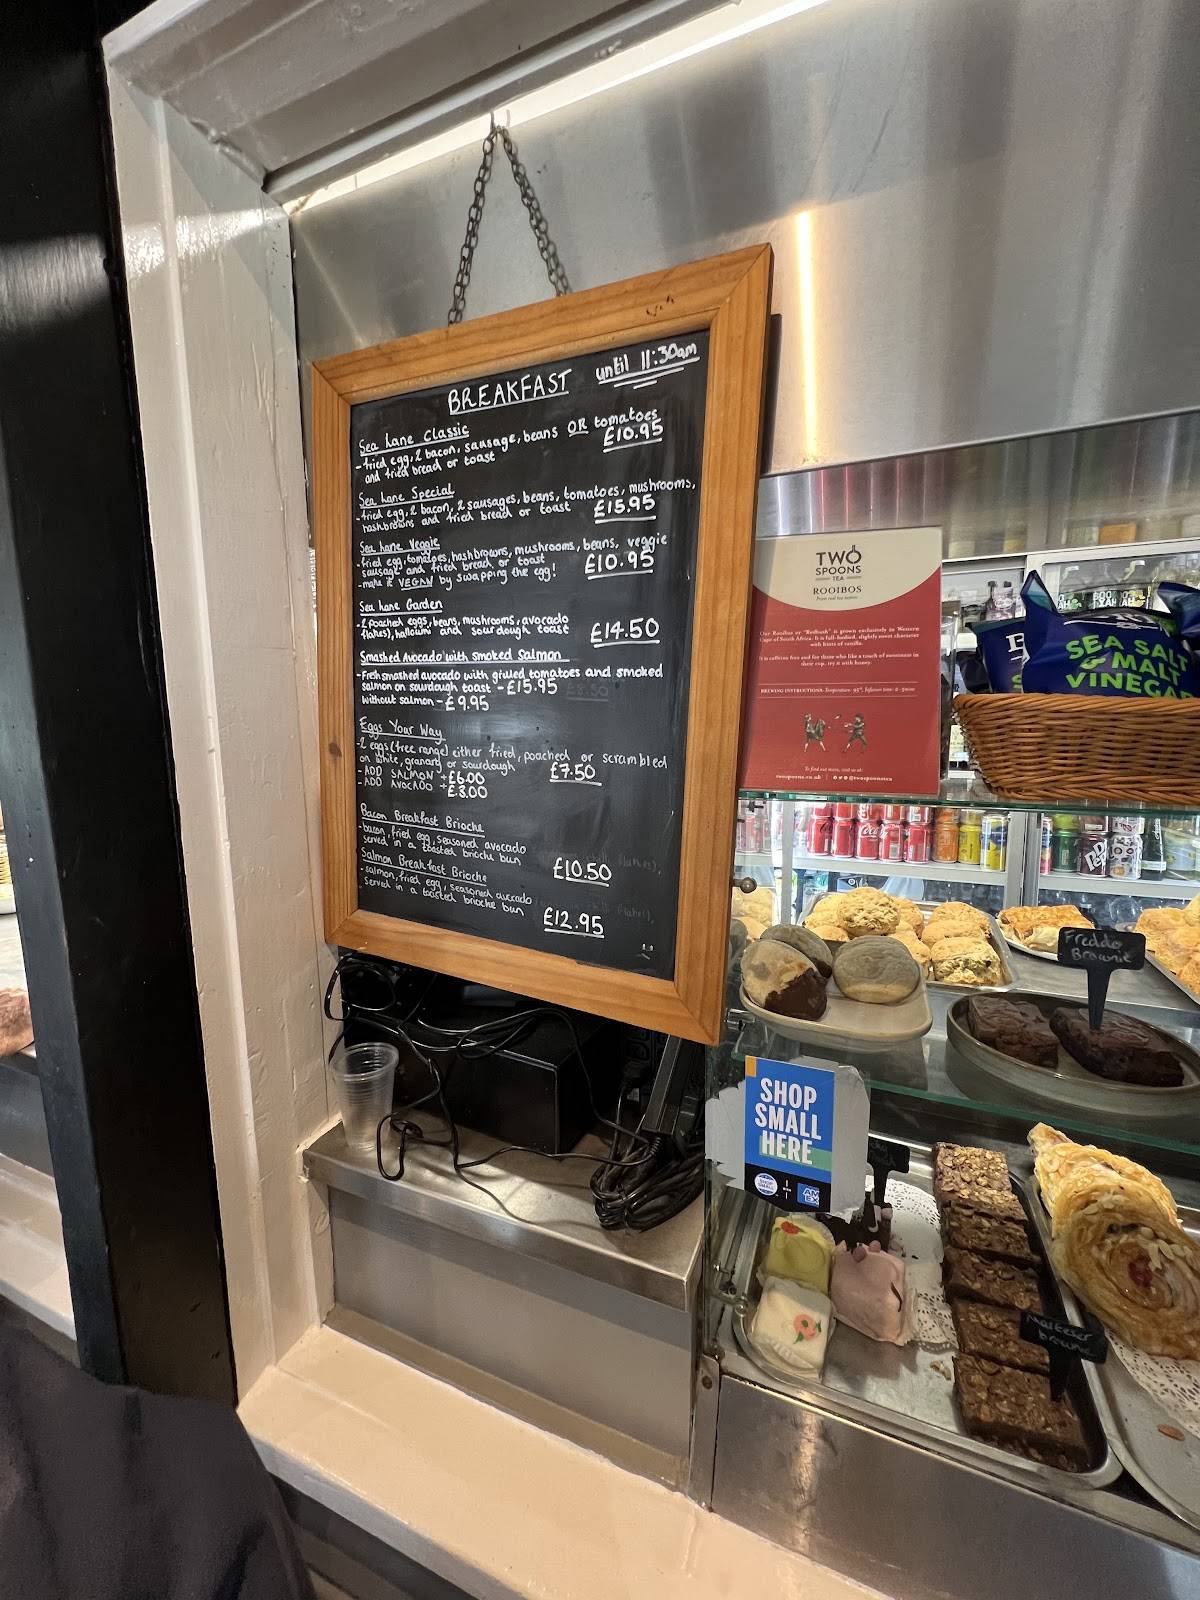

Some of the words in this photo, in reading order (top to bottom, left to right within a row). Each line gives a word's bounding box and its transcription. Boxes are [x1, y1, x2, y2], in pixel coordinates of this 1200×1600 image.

[595, 353, 629, 381] until
[641, 342, 697, 369] 11:30am
[448, 369, 573, 413] BREAKFAST
[359, 439, 380, 454] Sea
[424, 422, 469, 442] Classic
[425, 445, 461, 459] bacon,
[464, 433, 521, 452] sausage,
[523, 427, 558, 443] beans
[567, 417, 588, 434] OR
[594, 406, 658, 429] tomatoes
[603, 418, 664, 447] £10.95
[365, 471, 381, 484] and
[385, 466, 409, 479] fried
[412, 459, 442, 475] bread
[447, 458, 459, 469] or
[464, 450, 496, 466] toast
[358, 492, 377, 506] Sea
[412, 483, 455, 502] Special
[467, 493, 520, 511] sausages,
[523, 490, 560, 504] beans,
[564, 485, 625, 501] tomatoes,
[628, 478, 696, 494] mushrooms,
[594, 494, 656, 518] £15.95
[421, 516, 440, 526] and
[446, 512, 474, 523] fried
[480, 507, 512, 521] bread
[518, 507, 531, 517] or
[540, 501, 571, 515] toast
[360, 541, 376, 553] Sea
[409, 536, 440, 555] Veggie
[514, 540, 580, 556] mushrooms,
[627, 533, 667, 553] veggie
[816, 545, 862, 566] TWO
[362, 567, 400, 580] sausage
[406, 565, 425, 576] and
[431, 562, 457, 573] fried
[462, 557, 492, 571] bread
[498, 559, 509, 568] or
[517, 553, 545, 566] toast
[584, 550, 655, 574] £10.95
[816, 565, 862, 576] SPOONS
[398, 576, 433, 588] VEGAN
[439, 575, 452, 591] by
[456, 569, 508, 585] swapping
[511, 566, 529, 577] the
[813, 585, 862, 595] ROOIBOS
[360, 601, 375, 613] Sea
[406, 598, 443, 611] Garden
[368, 617, 403, 629] poached
[462, 614, 520, 626] mushrooms,
[521, 612, 569, 626] avocado
[440, 626, 463, 636] and
[471, 624, 531, 640] sourdough
[537, 625, 569, 635] toast
[591, 618, 660, 643] £14.50
[360, 650, 401, 663] Smashed
[402, 650, 443, 662] Avocado
[445, 649, 468, 661] with
[472, 648, 513, 661] smoked
[1066, 635, 1124, 659] SEA
[1134, 639, 1188, 672] SALT
[381, 669, 419, 680] smashed
[420, 669, 460, 680] avocado
[463, 669, 489, 680] with
[492, 667, 526, 684] grilled
[529, 667, 580, 679] tomatoes
[585, 666, 611, 677] and
[616, 663, 663, 678] smoked
[1111, 651, 1180, 686] MALT
[361, 681, 393, 692] salmon
[394, 683, 406, 692] on
[409, 681, 458, 695] sourdough
[462, 683, 491, 693] toast
[361, 694, 396, 705] without
[399, 694, 434, 706] salmon
[359, 716, 383, 740] Eggs
[389, 719, 415, 734] Your
[420, 724, 443, 746] Way
[359, 755, 370, 763] on
[404, 756, 442, 774] granary
[447, 760, 456, 768] or
[462, 761, 515, 776] sourdough
[370, 741, 388, 757] eggs
[452, 746, 482, 758] either
[524, 749, 570, 764] poached
[581, 753, 594, 762] or
[602, 753, 668, 769] scrambled
[391, 768, 435, 781] SALMON
[550, 761, 596, 781] £7.50
[390, 779, 434, 792] AVOCADO
[360, 802, 388, 821] Bacon
[394, 809, 440, 827] Breakfast
[445, 815, 485, 833] Brioche
[393, 836, 402, 848] in
[422, 842, 457, 857] toasted
[499, 853, 521, 866] bun
[436, 835, 479, 849] seasoned
[484, 841, 527, 855] avocado
[361, 847, 393, 865] Salmon
[398, 854, 446, 876] Breakfast
[451, 866, 487, 883] Brioche
[553, 857, 612, 881] £10.50
[422, 887, 457, 903] toasted
[463, 895, 497, 909] brioche
[502, 902, 525, 916] bun
[450, 883, 493, 899] seasoned
[495, 891, 533, 905] avocado
[543, 906, 604, 935] £12.95
[760, 1078, 817, 1111] SHOP
[754, 1102, 822, 1141] SMALL
[761, 1130, 813, 1165] HERE
